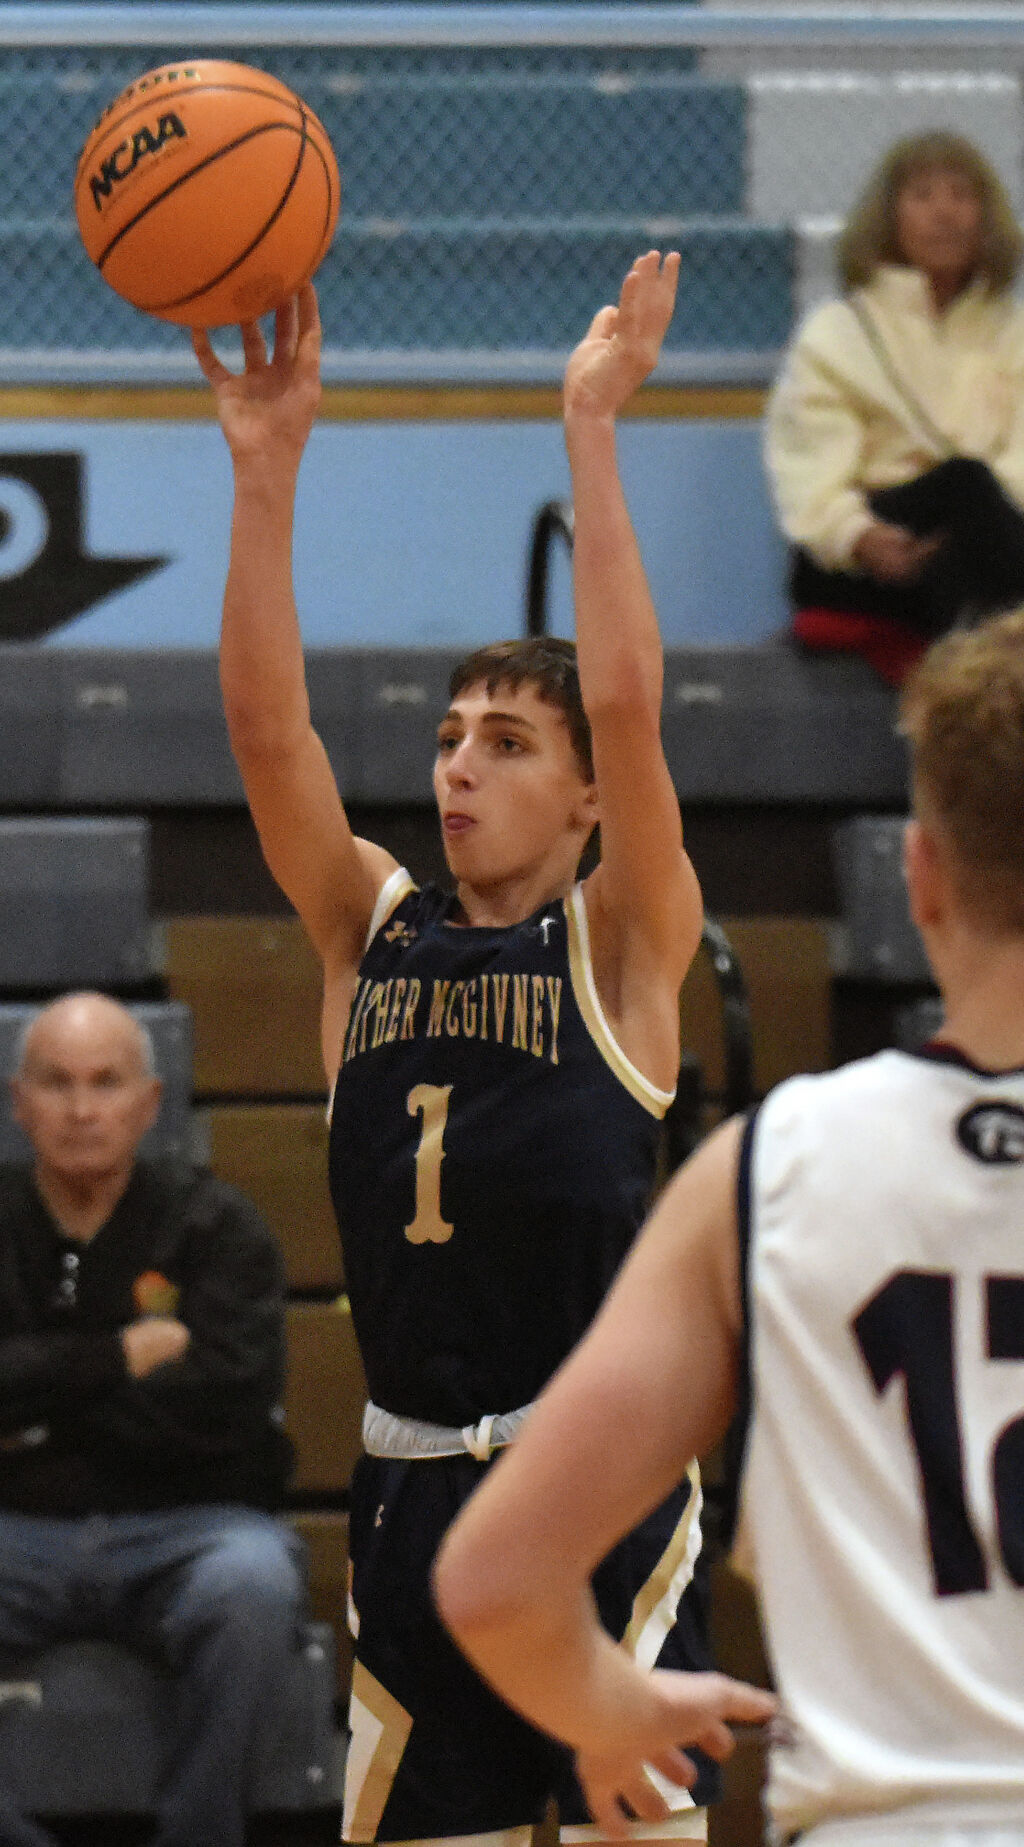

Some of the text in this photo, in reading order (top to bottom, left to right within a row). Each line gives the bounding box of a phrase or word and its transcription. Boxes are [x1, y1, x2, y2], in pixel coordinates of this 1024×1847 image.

[89, 111, 187, 213] NCAA
[345, 973, 563, 1066] ATHER MCGIVNEY
[404, 1083, 455, 1244] 1
[849, 1268, 1024, 1596] 1
